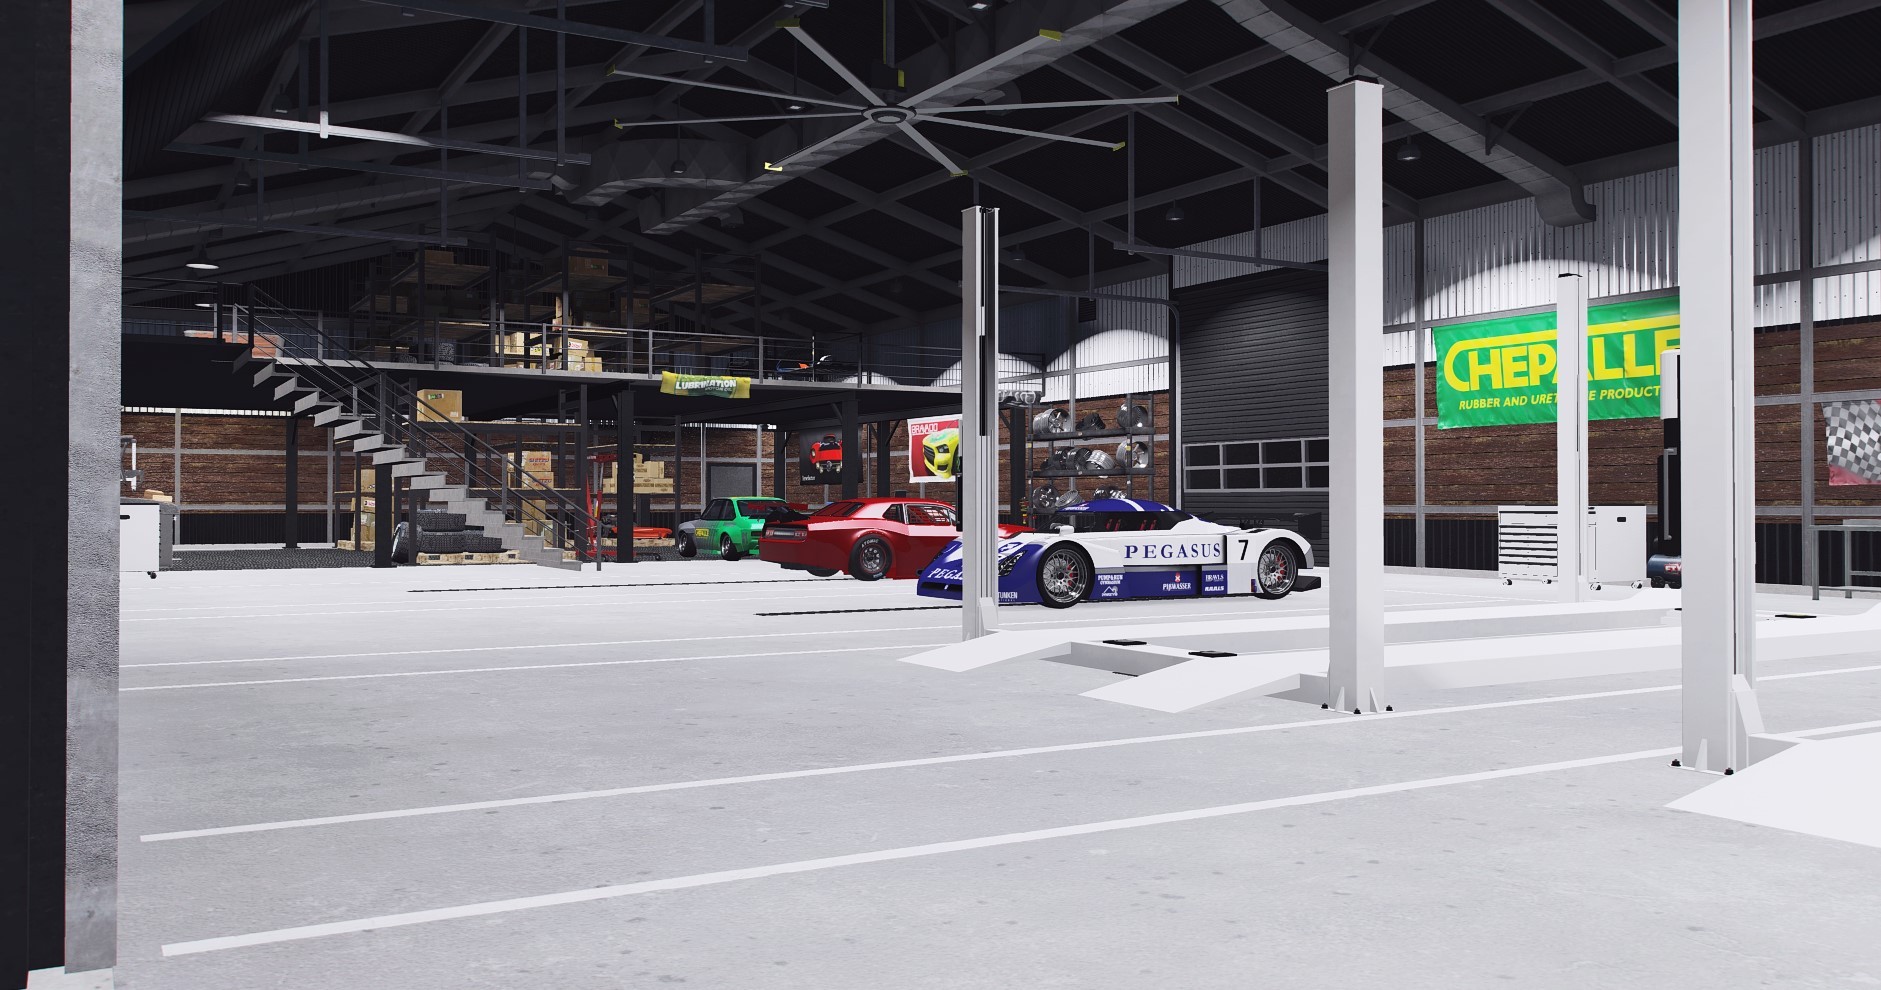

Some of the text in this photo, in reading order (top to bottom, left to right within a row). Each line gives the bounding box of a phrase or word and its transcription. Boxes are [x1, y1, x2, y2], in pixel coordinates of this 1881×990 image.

[1444, 314, 1680, 391] CHEPLLE
[1459, 385, 1661, 410] RUBBER AND URETE PRODUCT
[1124, 542, 1221, 559] PEGASUS
[1238, 539, 1249, 561] 7
[927, 567, 963, 580] PEGA
